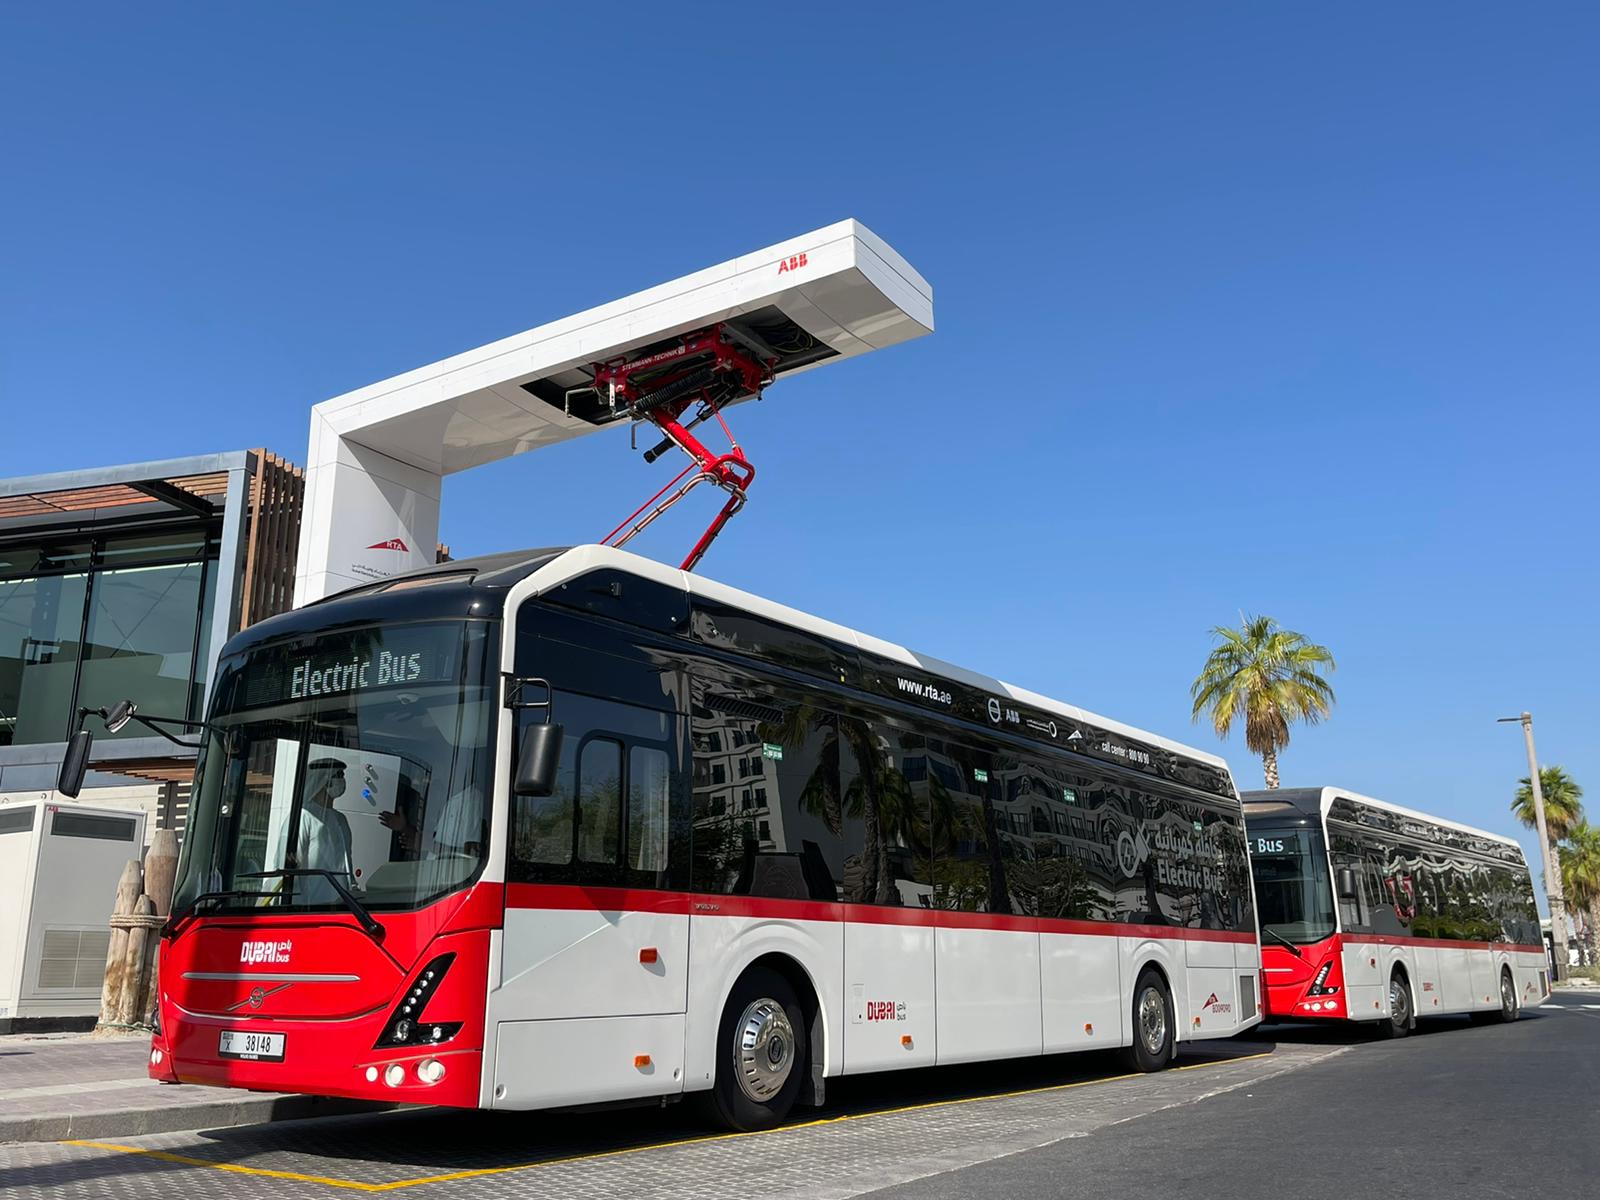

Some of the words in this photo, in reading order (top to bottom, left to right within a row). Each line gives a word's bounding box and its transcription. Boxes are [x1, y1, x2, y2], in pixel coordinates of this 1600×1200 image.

[778, 253, 808, 275] ABB
[386, 541, 403, 550] RTA
[290, 656, 370, 698] Electric
[378, 650, 421, 684] Bus
[897, 677, 952, 705] www.rta.ae
[1006, 708, 1020, 724] ABB
[1102, 742, 1110, 753] call
[1111, 745, 1126, 757] center
[1258, 838, 1284, 853] Bus
[1158, 859, 1202, 889] Electric
[240, 941, 278, 965] DUBAI
[276, 952, 290, 963] bus
[867, 1001, 896, 1023] DUBAI
[225, 1040, 231, 1051] X
[245, 1035, 271, 1053] 38148
